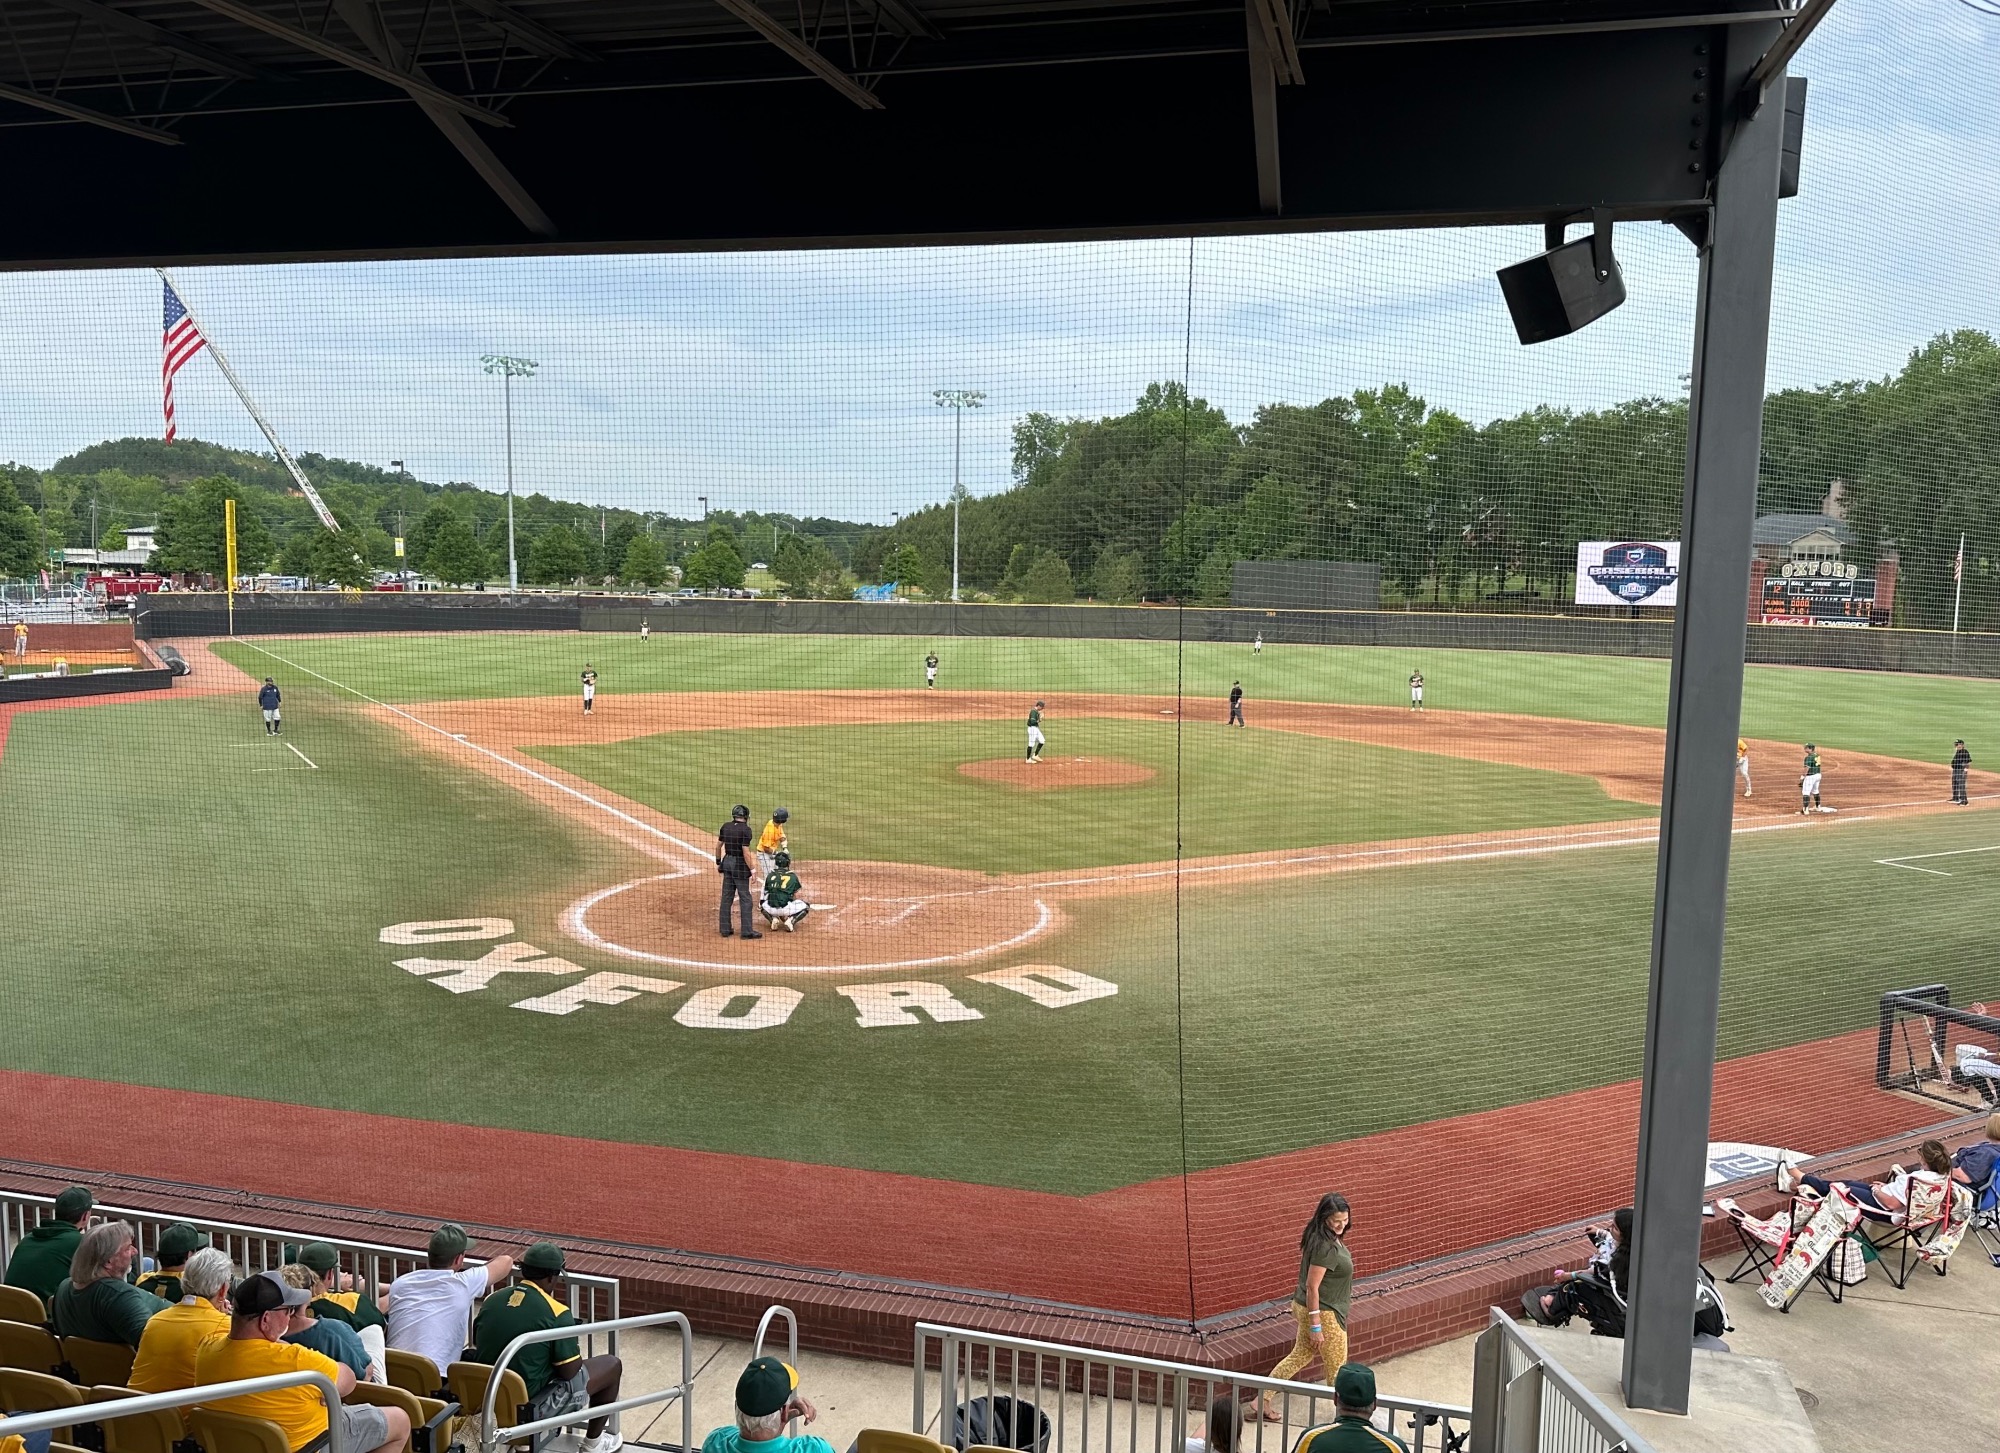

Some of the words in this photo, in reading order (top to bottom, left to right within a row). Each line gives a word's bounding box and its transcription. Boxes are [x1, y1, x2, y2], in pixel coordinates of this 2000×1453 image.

[1589, 567, 1678, 576] BASEBALL
[1781, 561, 1857, 579] OXFORD
[1817, 620, 1869, 628] POWERADE
[379, 917, 1118, 1029] OXFORD
